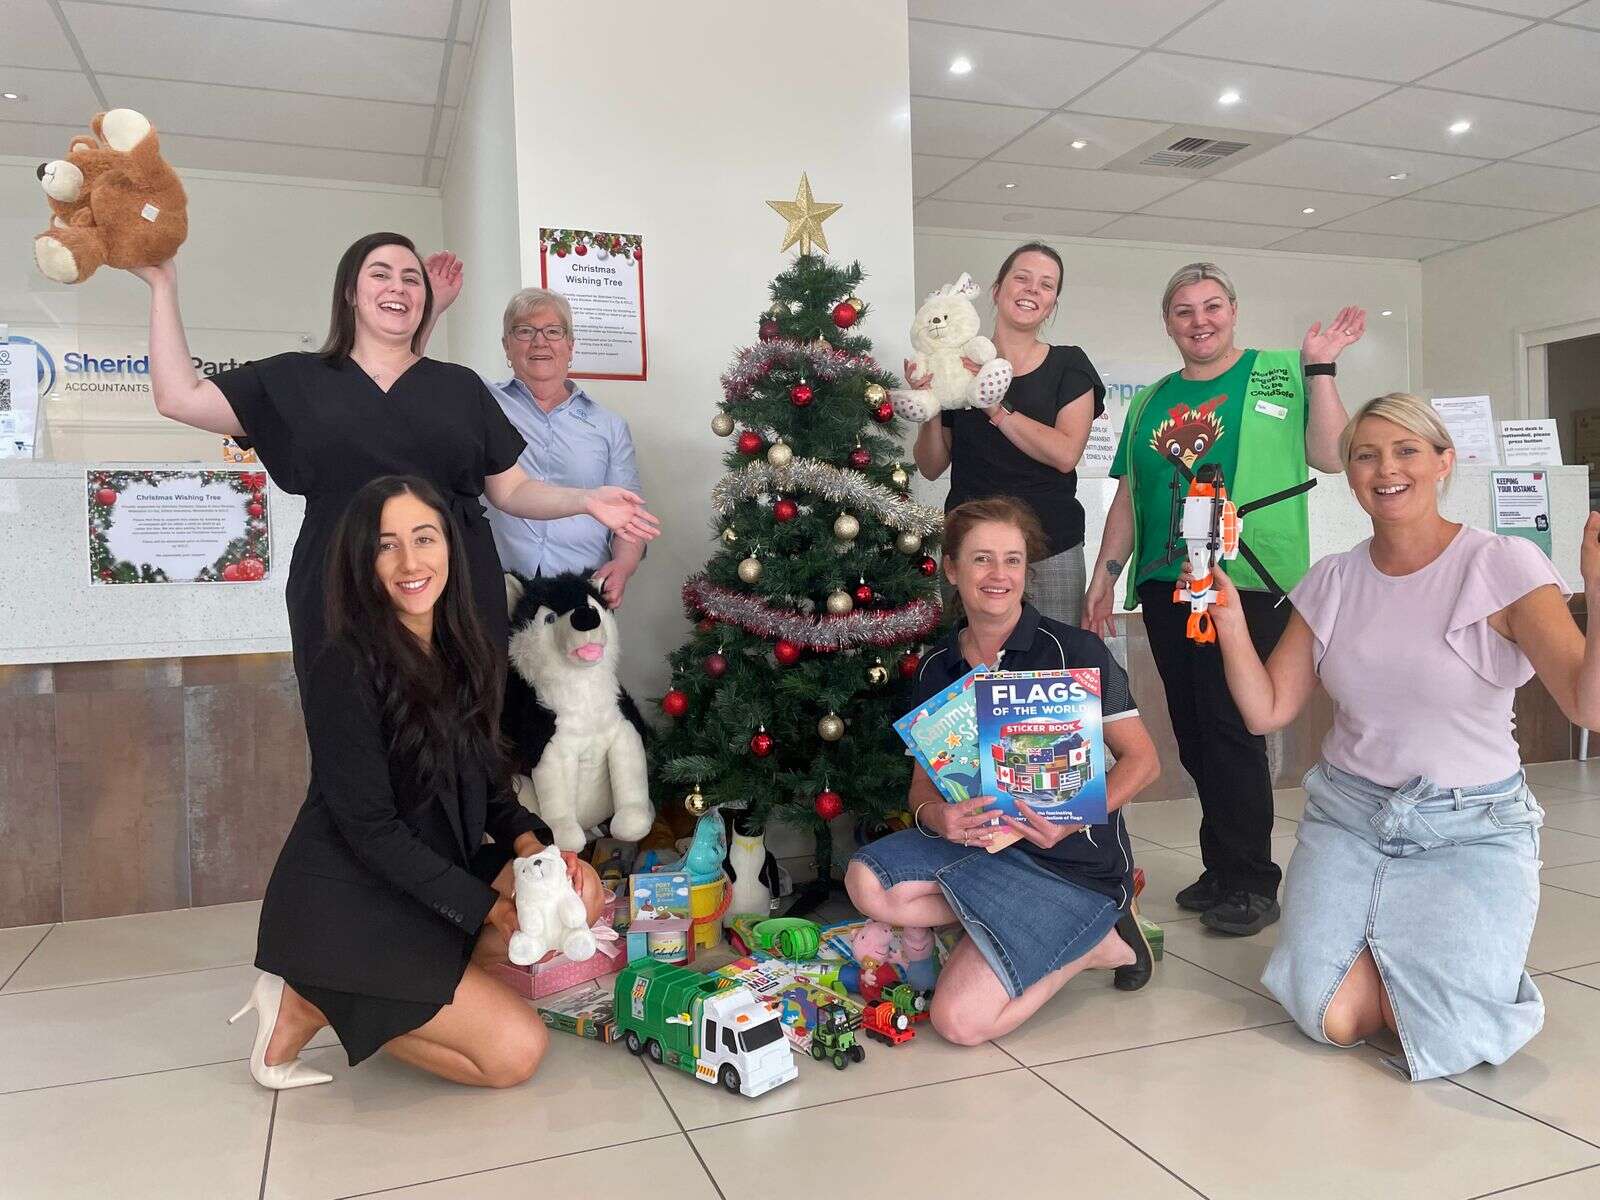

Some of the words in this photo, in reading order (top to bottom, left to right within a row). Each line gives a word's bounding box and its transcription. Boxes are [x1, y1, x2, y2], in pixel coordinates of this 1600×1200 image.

[571, 263, 616, 274] Christmas
[565, 275, 602, 287] Wishing
[603, 278, 623, 287] Tree
[64, 352, 150, 374] Sherid
[191, 357, 237, 376] Part
[65, 382, 150, 393] ACCOUNTANTS
[1496, 477, 1519, 485] KEEPING
[1497, 485, 1512, 493] YOUR
[174, 494, 204, 502] Wishing
[991, 682, 1088, 705] FLAGS
[992, 707, 1010, 717] OF
[1014, 706, 1038, 716] THE
[1041, 704, 1089, 714] WORLD
[1006, 725, 1046, 733] STICKER
[1048, 723, 1077, 732] BOOK
